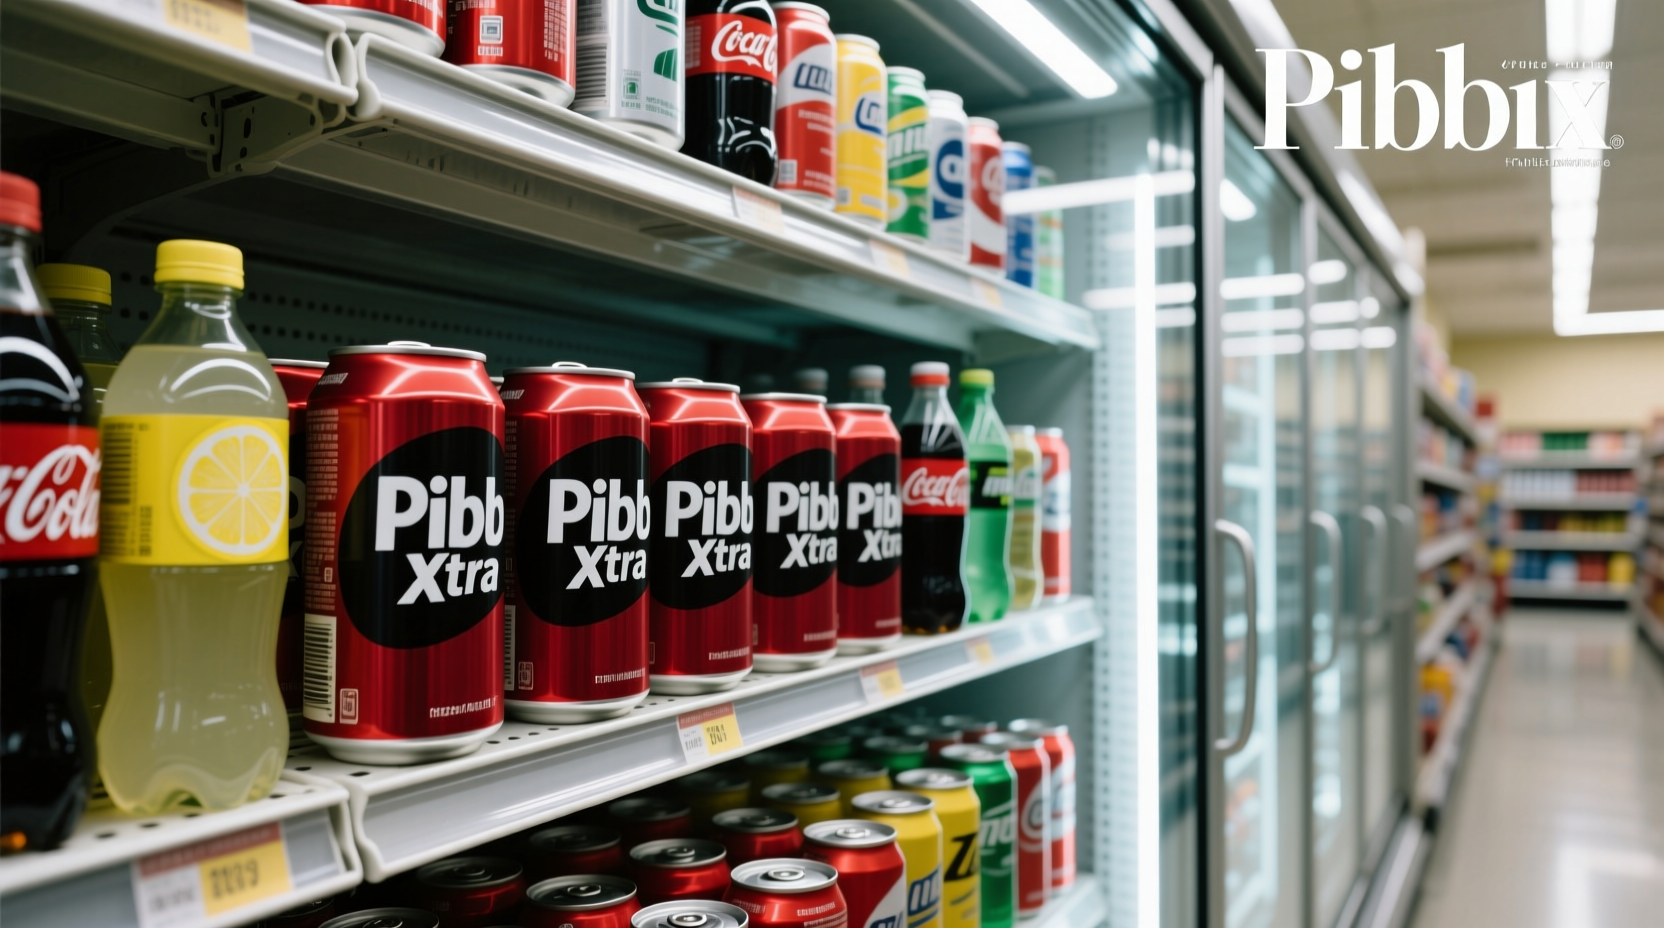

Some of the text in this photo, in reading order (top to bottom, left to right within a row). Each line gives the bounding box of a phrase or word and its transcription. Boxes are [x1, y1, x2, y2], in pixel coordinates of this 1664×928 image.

[375, 475, 504, 551] Pibb
[547, 478, 650, 543] Pibb
[665, 480, 753, 537] Pibb
[766, 481, 839, 533] Pibb
[565, 545, 646, 590] Xtra
[681, 538, 751, 578] Xtra
[780, 533, 837, 569] Xtra
[397, 553, 499, 605] Xtra
